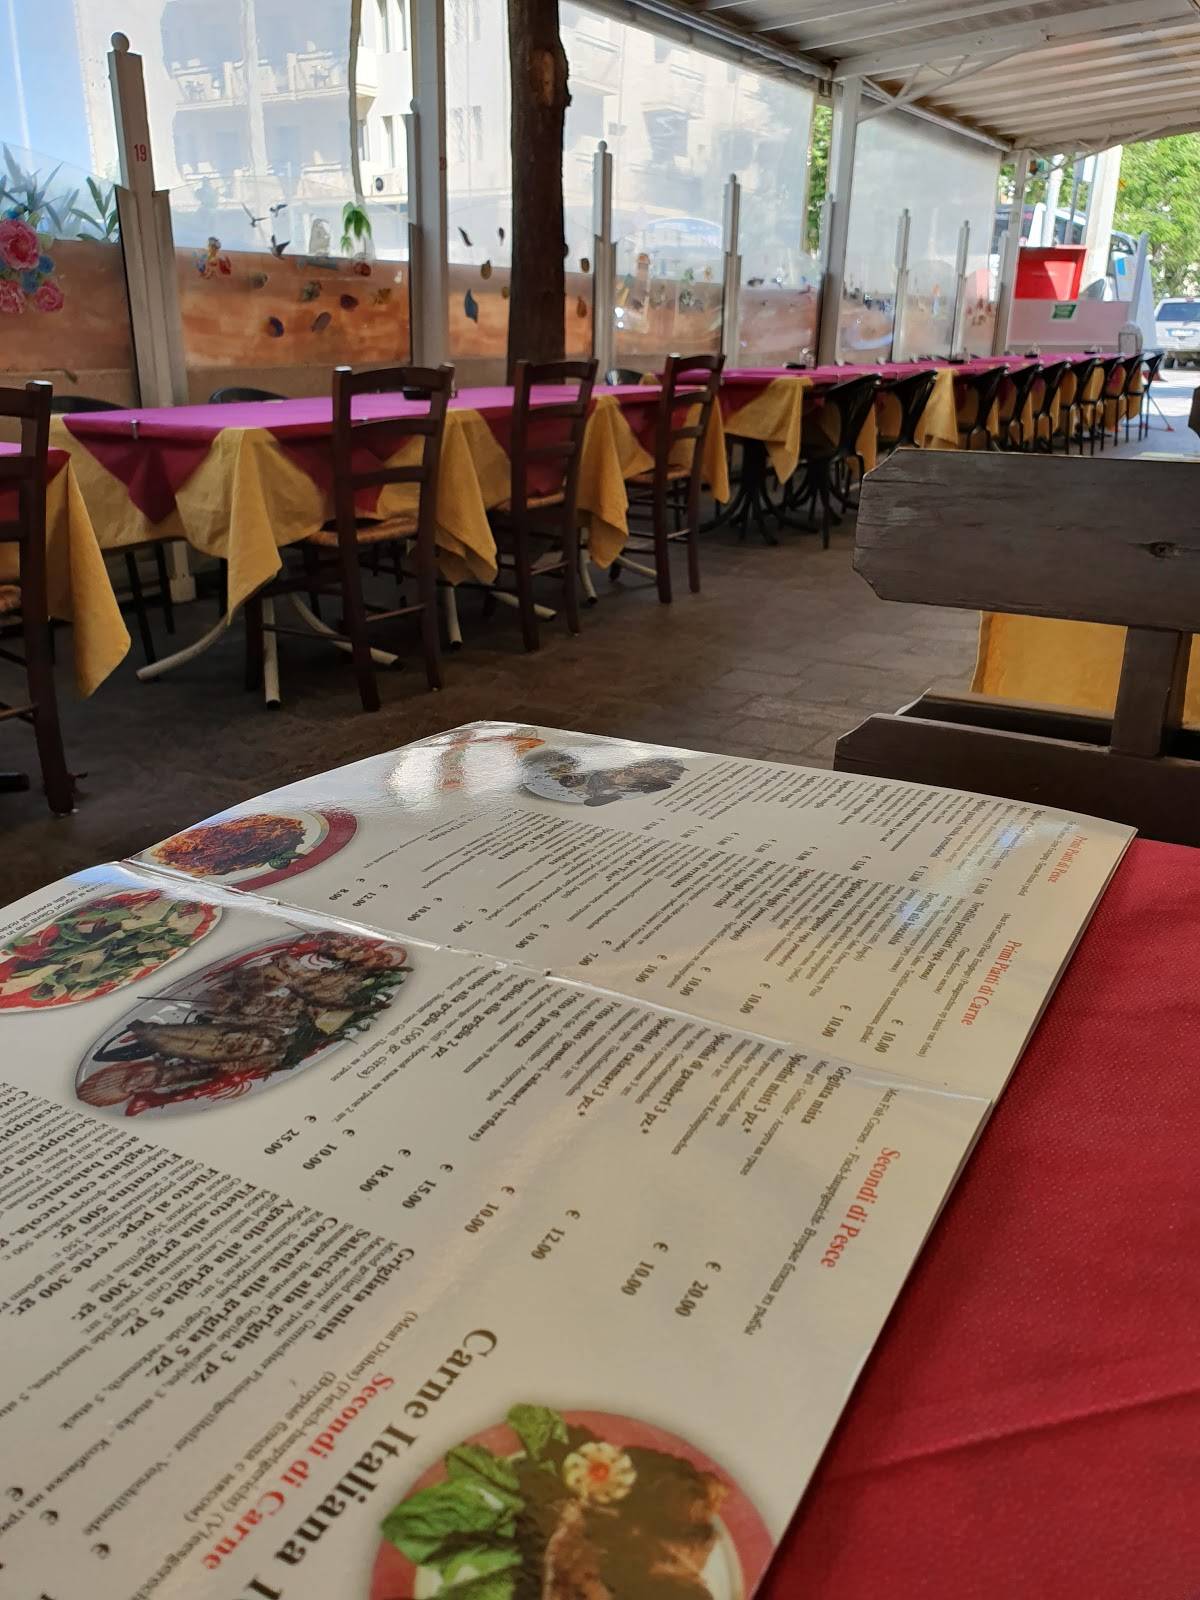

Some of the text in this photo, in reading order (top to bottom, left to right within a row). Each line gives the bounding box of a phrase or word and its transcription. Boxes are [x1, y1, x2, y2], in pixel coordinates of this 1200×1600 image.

[134, 144, 147, 162] 19
[960, 939, 1022, 1025] Primi Piatti di Carne
[631, 1042, 645, 1053] di
[640, 1016, 675, 1044] Spiedini
[697, 1032, 732, 1060] Spiedini
[263, 968, 502, 1155] Rombo alla griglia (500 gr. circa) € 25.00
[302, 977, 535, 1170] Sogliola alla griglia 2 pz. € 10.00
[359, 991, 585, 1192] Fritto di paranza € 18.00
[591, 1088, 604, 1097] 3
[597, 1051, 635, 1089] calamari
[659, 1068, 693, 1106] gamberi
[688, 1059, 704, 1070] di
[774, 1052, 807, 1083] Spiedini
[401, 1001, 621, 1208] Fritto misto (gamberi, calamari, verdure) € 15.00
[653, 1104, 667, 1114] 3
[752, 1104, 767, 1113] 3
[757, 1082, 780, 1105] misti
[16, 1117, 96, 1166] Scaloppina
[27, 1135, 139, 1210] aceto balsamico
[9, 1143, 157, 1236] Tagliata con rucola,
[53, 1152, 182, 1239] Fiorentina 500 gr.
[464, 1203, 499, 1233] 10.00
[500, 1185, 515, 1195] €
[565, 1208, 580, 1219] €
[674, 1065, 851, 1317] Grigliata mista € 20.00
[820, 1147, 900, 1267] Secondi di Pesce
[9, 1167, 219, 1315] Filetto al pepe verde 300 gr.
[71, 1182, 256, 1320] Filetto alla griglia 300 gr.
[120, 1199, 293, 1336] Agnello alla griglia 5 pz.
[530, 1227, 565, 1259] 12.00
[652, 1241, 669, 1252] €
[620, 1261, 654, 1295] 10.00
[6, 1216, 338, 1503] Costarelle alla griglia 5 pz. €
[39, 1228, 370, 1526] Salsiccia alla griglia 3 pz. €
[404, 1329, 497, 1418] Carne
[90, 1247, 414, 1560] Grigliata mista €
[204, 1373, 393, 1569] Secondi di Carne
[275, 1426, 415, 1564] Italiana
